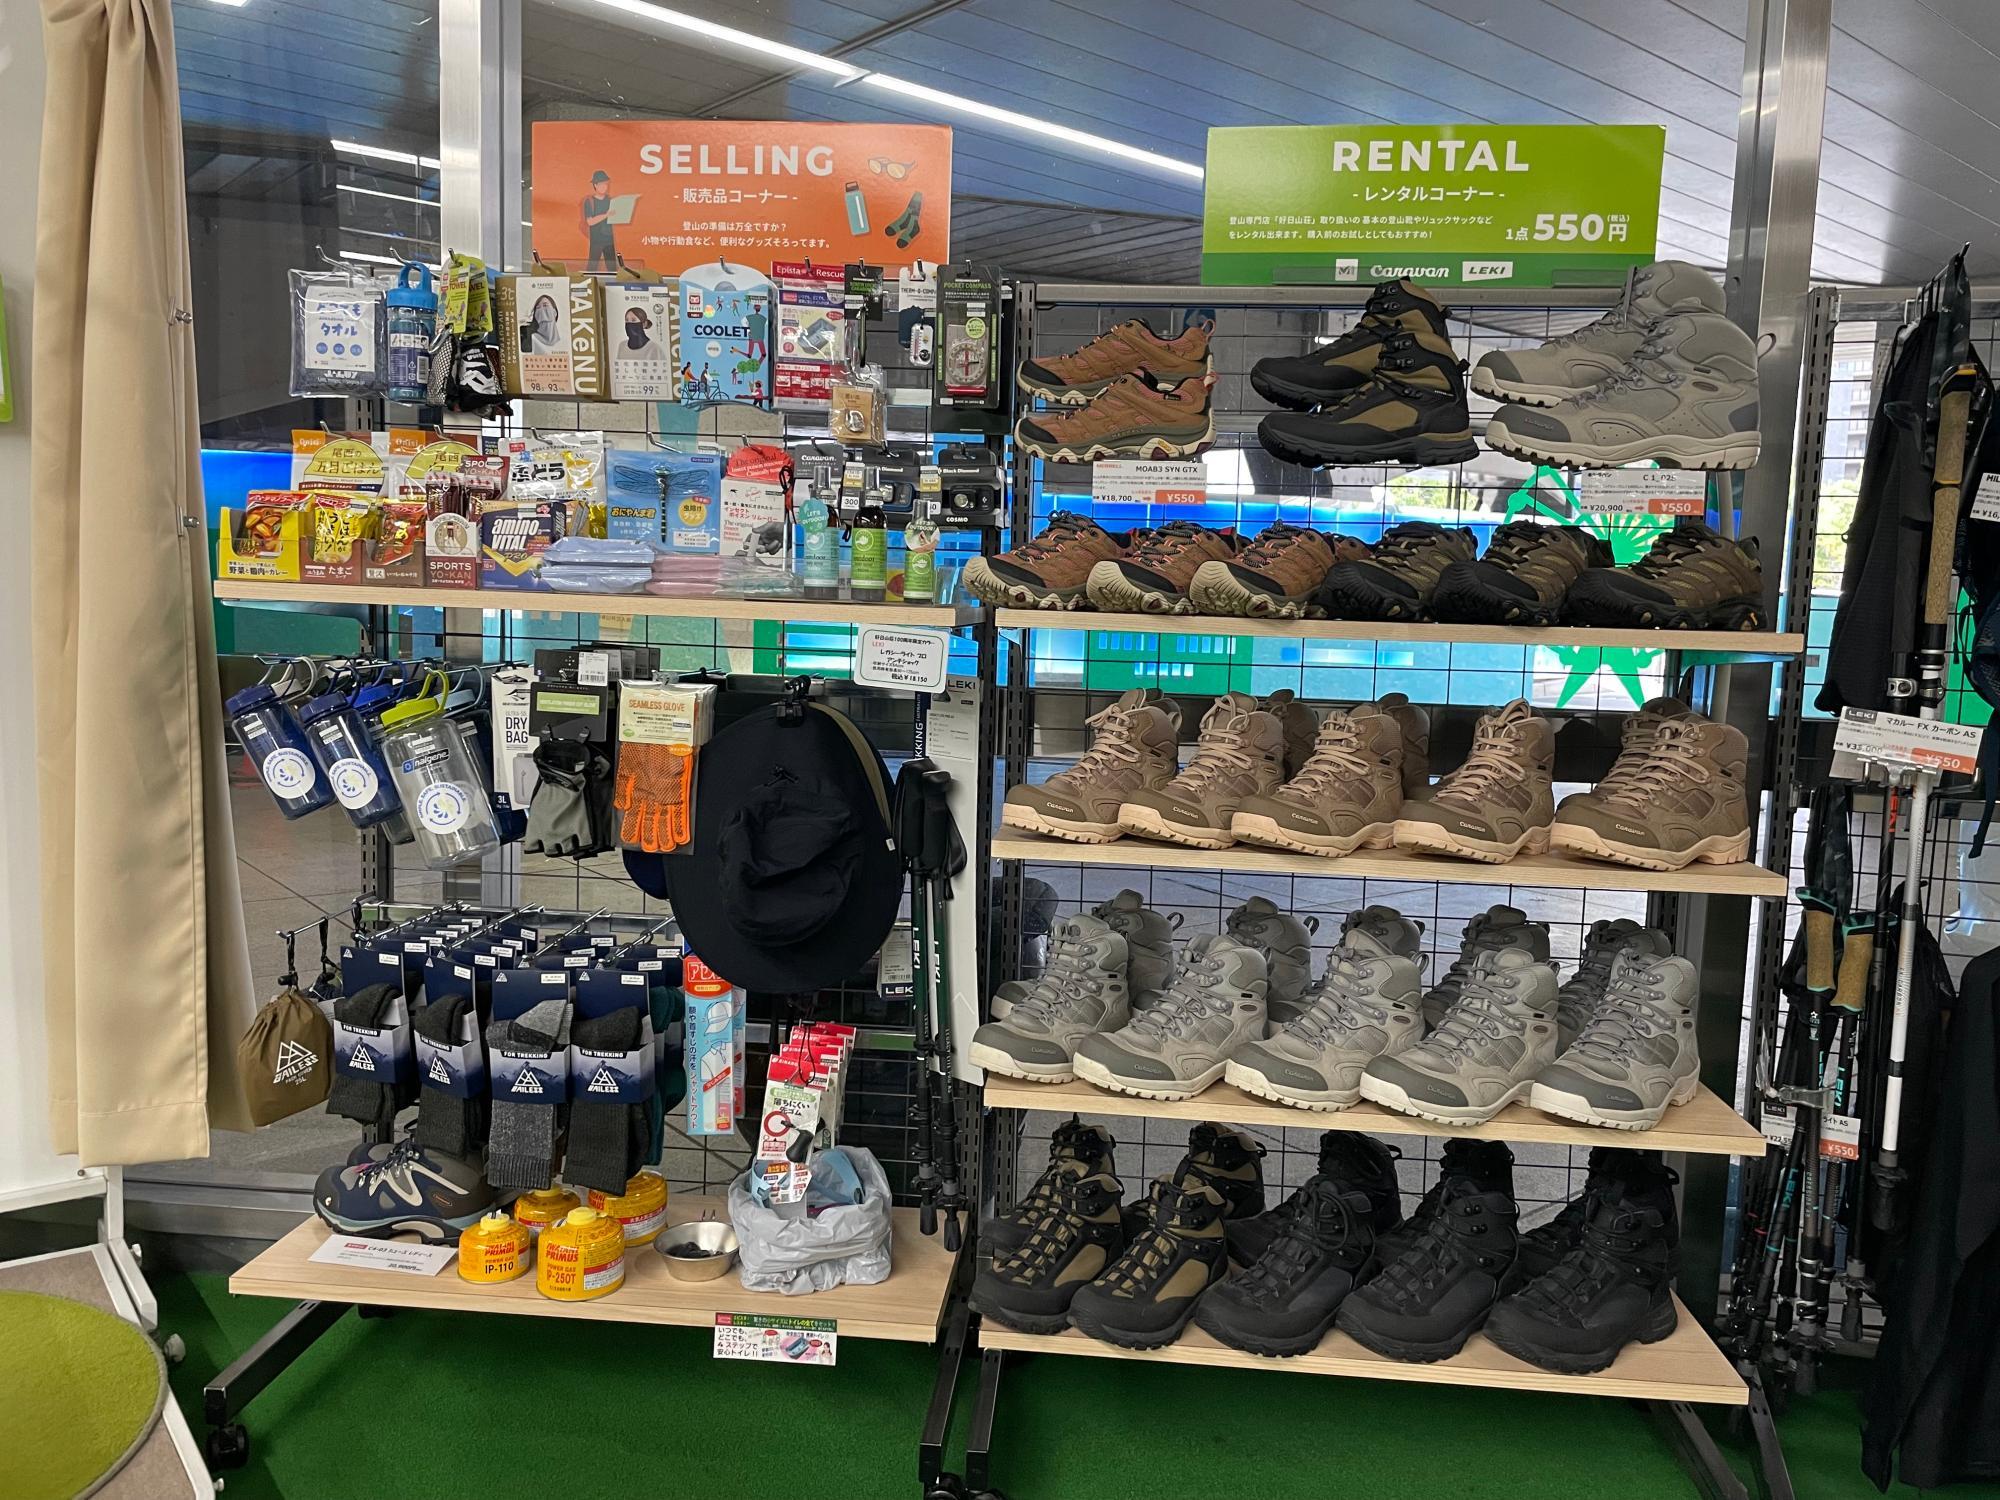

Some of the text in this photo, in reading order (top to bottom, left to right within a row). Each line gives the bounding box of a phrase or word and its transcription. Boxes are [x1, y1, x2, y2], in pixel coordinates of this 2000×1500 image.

[639, 143, 834, 177] SELLING
[1332, 140, 1530, 172] RENTAL
[682, 187, 788, 204] 販売品コーナー
[1364, 185, 1495, 202] レンタルコーナー
[815, 268, 845, 279] Rescue
[1370, 264, 1450, 279] Caravan
[1467, 265, 1507, 276] LEKI
[1135, 465, 1163, 473] MOAB3
[1182, 466, 1198, 474] GTX
[844, 498, 860, 506] 300
[1101, 494, 1133, 502] ¥18,700
[1166, 493, 1196, 504] ¥550
[611, 506, 657, 519] おにやんま君
[1589, 504, 1624, 512] ¥20,900
[1660, 502, 1692, 513] ¥550
[491, 518, 540, 536] amino
[491, 534, 528, 551] VITAL
[328, 566, 353, 576] たまご
[429, 561, 472, 571] SPORTS
[430, 570, 472, 580] YO-KAN
[947, 679, 976, 690] LEKI
[628, 698, 687, 712] SEAMLESS GLOVE
[1848, 710, 1875, 719] LEKI
[505, 717, 528, 730] DRY
[1916, 723, 1929, 731] FX
[1962, 730, 1977, 739] AS
[505, 730, 529, 744] BAG
[414, 751, 449, 767] nalgene
[497, 795, 507, 804] 3L
[516, 1052, 548, 1060] TREKKING
[593, 1050, 624, 1059] TREKKING
[348, 1060, 376, 1072] BAILESS
[510, 1085, 544, 1094] BAILESS
[587, 1085, 620, 1094] BAILESS
[545, 1251, 579, 1263] PRIMUS
[484, 1261, 515, 1275] IP-110
[546, 1271, 577, 1286] IP-250T
